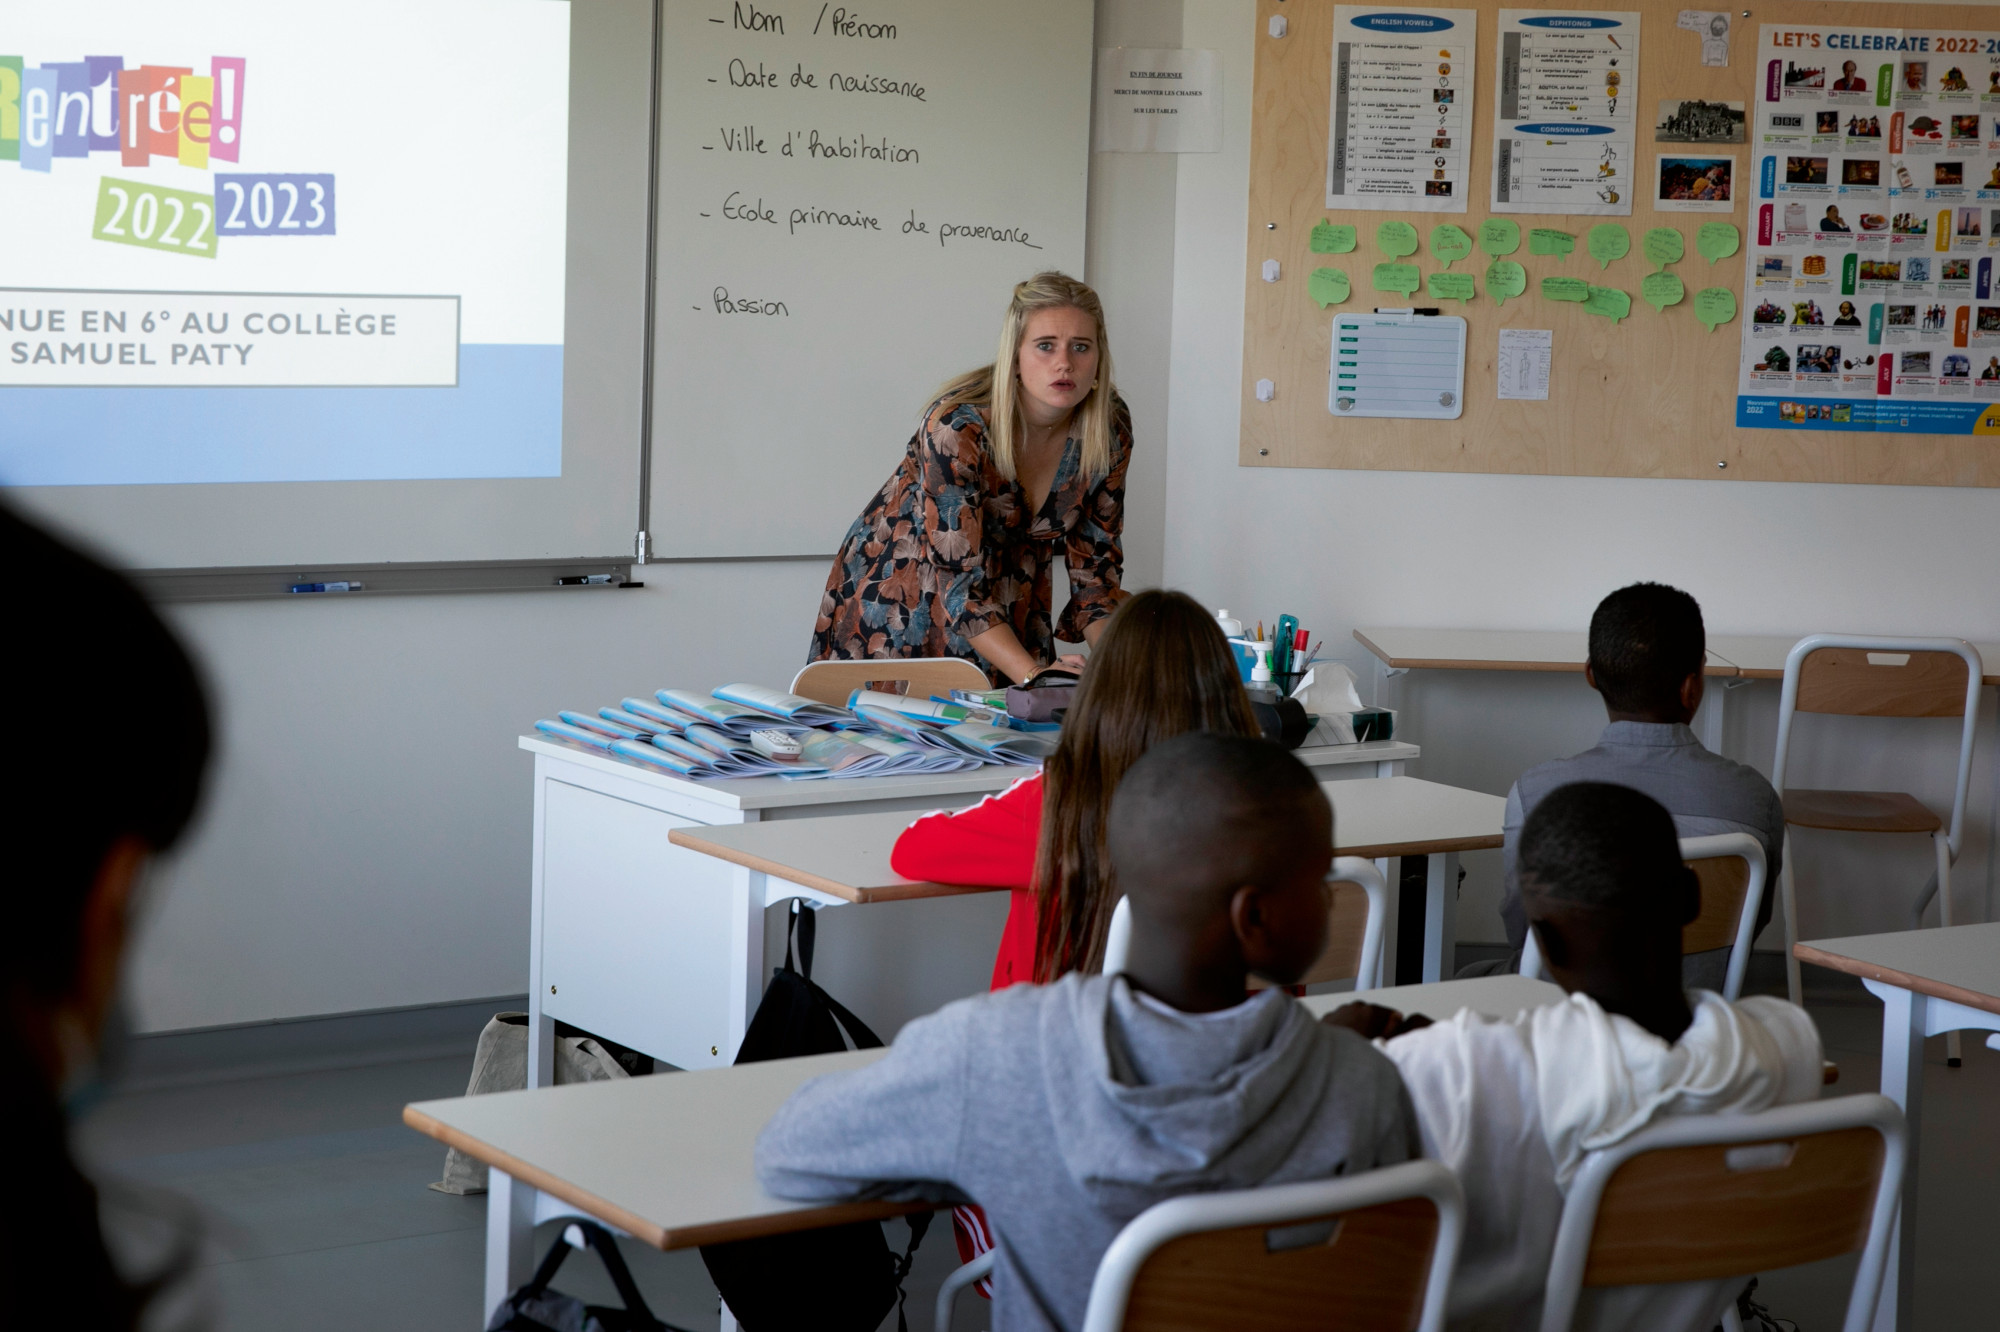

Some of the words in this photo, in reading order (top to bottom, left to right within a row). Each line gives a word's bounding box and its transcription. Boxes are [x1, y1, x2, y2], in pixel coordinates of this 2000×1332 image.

[734, 1, 784, 34] Nom
[833, 8, 897, 39] Prénom
[1371, 18, 1402, 26] ENGLISH
[1404, 19, 1434, 27] VOWELS
[1773, 32, 1821, 48] LET'S
[1826, 34, 1929, 52] CELEBRATE
[729, 58, 778, 88] Date
[790, 63, 818, 89] de
[830, 73, 927, 102] naissance
[1340, 61, 1348, 95] LONGUES
[1773, 116, 1801, 126] BBC
[721, 125, 768, 154] Ville
[1336, 138, 1344, 170] COURTES
[1500, 148, 1508, 193] CONSONNES
[102, 187, 212, 251] 2022
[223, 181, 326, 229] 2023
[722, 191, 778, 224] Ecole
[790, 206, 882, 235] primaire
[902, 209, 930, 233] de
[939, 222, 1043, 249] provenance
[713, 286, 789, 316] Passion
[82, 310, 127, 334] EN
[140, 310, 171, 334] 6°
[180, 311, 229, 334] AU
[242, 306, 397, 336] COLLÈGE
[10, 341, 157, 366] SAMUEL
[170, 343, 255, 366] PATY
[1746, 406, 1764, 414] 2022
